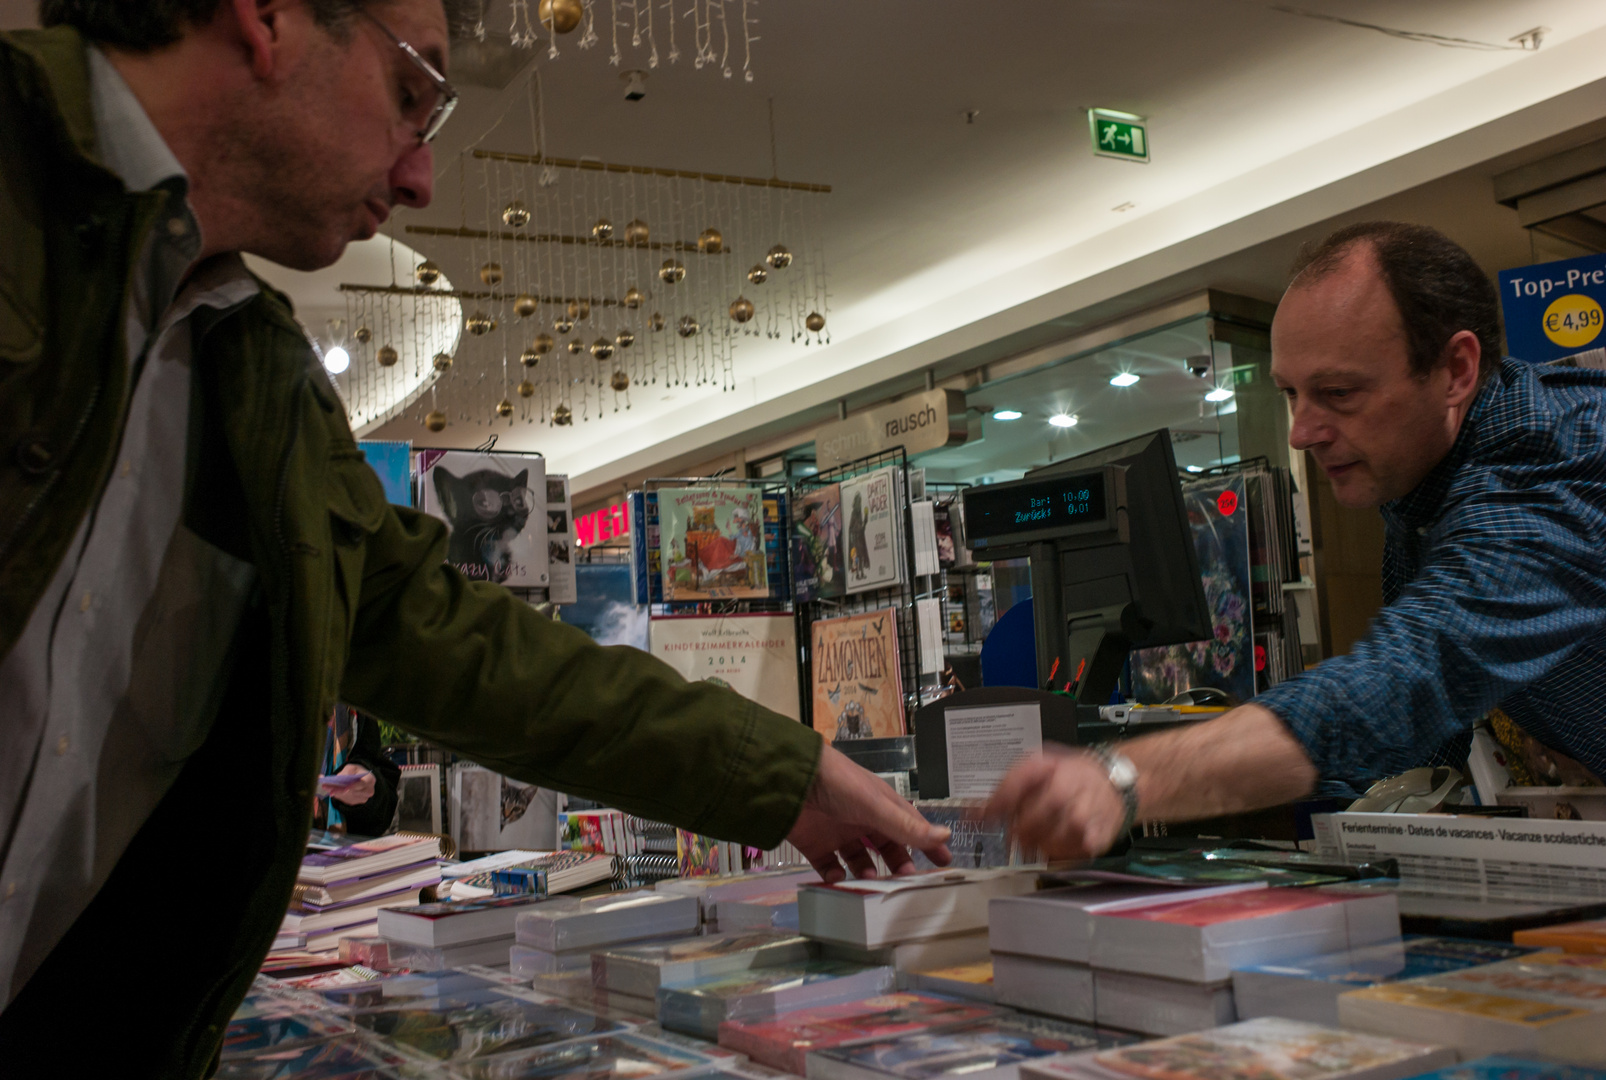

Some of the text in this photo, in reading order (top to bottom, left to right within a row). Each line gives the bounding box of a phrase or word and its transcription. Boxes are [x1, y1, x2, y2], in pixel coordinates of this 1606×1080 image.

[1546, 310, 1600, 332] € 4,99
[886, 404, 936, 438] rausch
[1030, 496, 1050, 508] Bar:
[664, 639, 786, 651] KINDERZIMMERKALENDER
[708, 655, 747, 665] 2014
[818, 635, 888, 684] ZAMONIEN
[951, 833, 975, 848] 2014
[1341, 821, 1403, 835] Ferientermine
[1407, 824, 1434, 837] Dates
[1435, 824, 1448, 837] de
[1450, 828, 1495, 840] vacances
[1498, 829, 1541, 843] Vacanze
